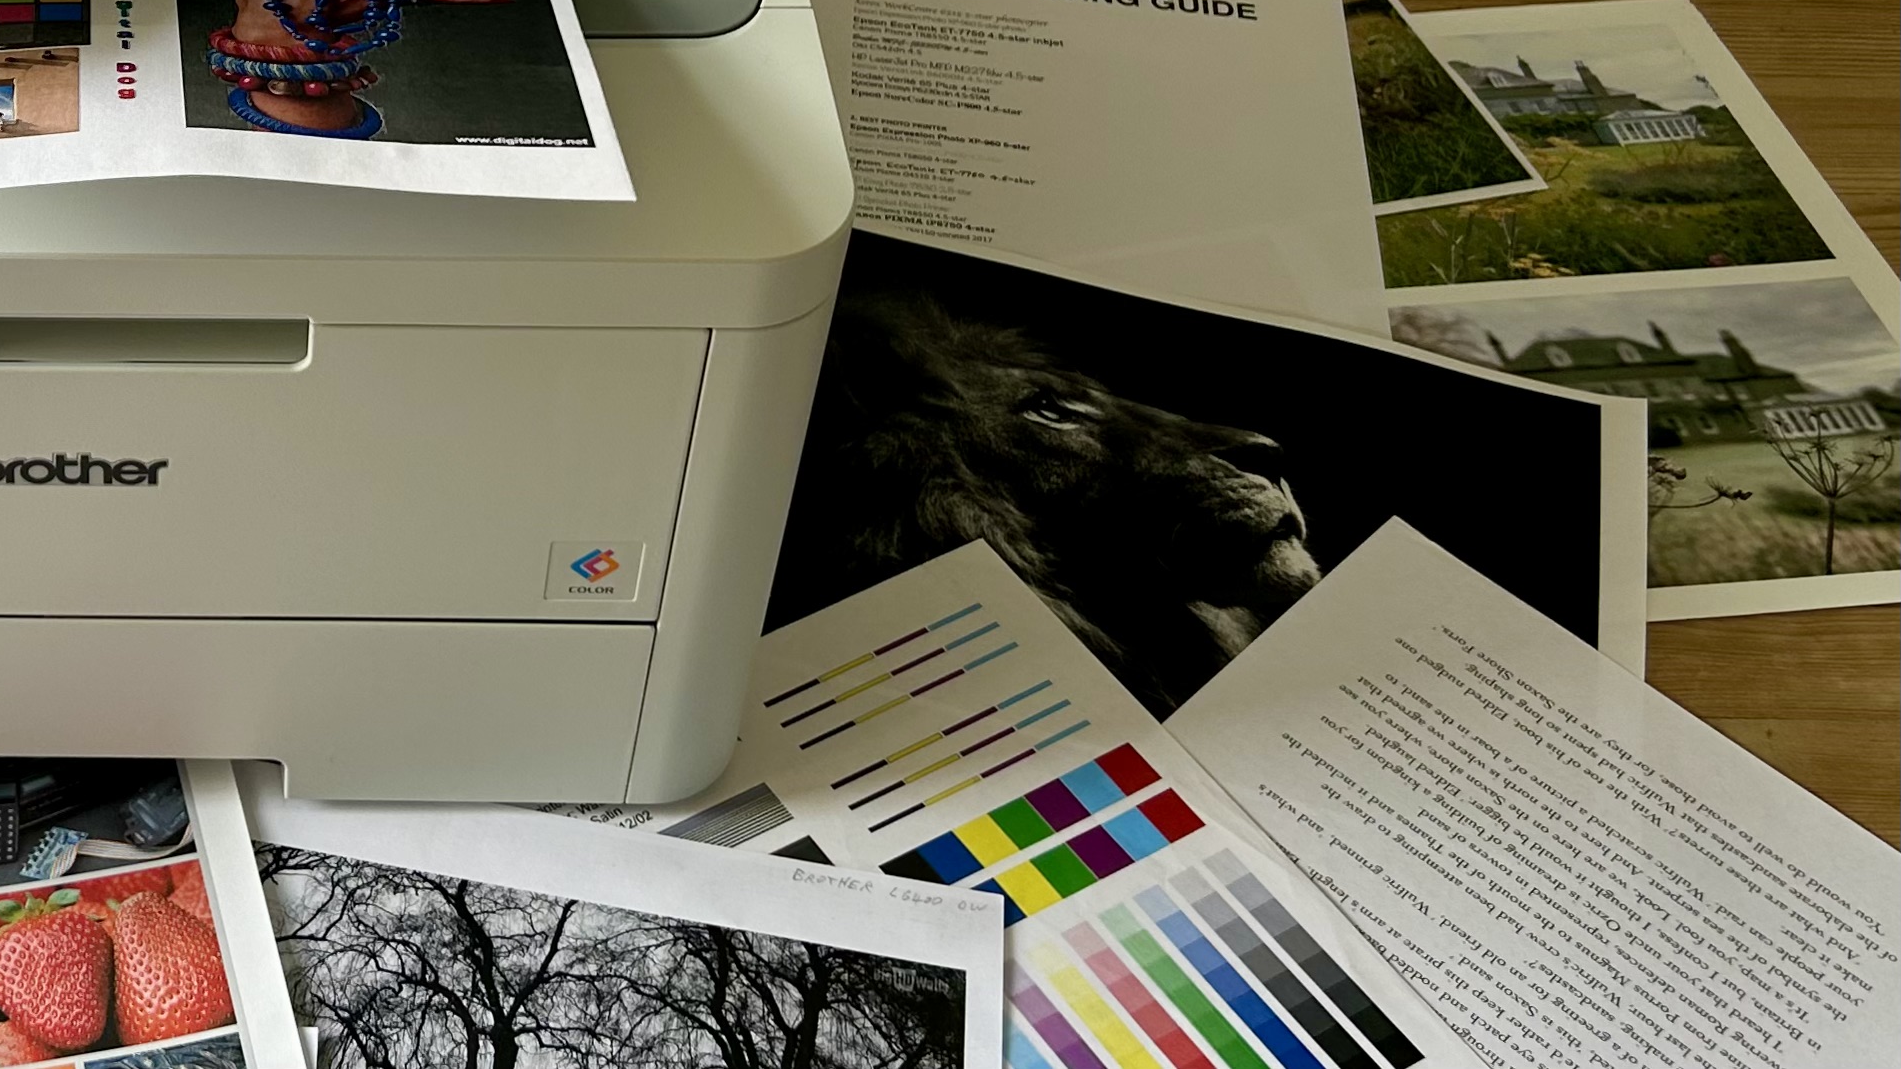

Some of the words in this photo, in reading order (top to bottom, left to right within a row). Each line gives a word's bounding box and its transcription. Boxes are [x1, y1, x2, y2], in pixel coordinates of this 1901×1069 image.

[852, 16, 886, 26] Epson
[889, 20, 937, 32] EcoTank
[1032, 37, 1063, 48] inkjet
[116, 63, 137, 99] Dog
[851, 71, 883, 80] Kodak
[851, 88, 881, 99] Epson
[849, 123, 879, 133] Epson
[882, 127, 935, 140] Expression
[937, 133, 965, 143] Photo
[880, 118, 909, 127] PHOTO
[912, 122, 947, 131] PRINTER
[455, 136, 588, 146] www.digitaldog.net
[568, 586, 614, 594] COLOR
[1394, 637, 1417, 654] one
[1415, 653, 1465, 688] nudged
[1476, 651, 1514, 680] Shore
[1384, 673, 1398, 685] to
[1462, 687, 1509, 721] Eldred
[1516, 678, 1555, 710] Saxon
[1433, 708, 1454, 725] the
[1514, 698, 1544, 724] long
[1557, 707, 1578, 724] the
[1456, 723, 1470, 738] in
[1545, 721, 1562, 733] so
[1579, 722, 1602, 739] are
[1469, 735, 1501, 760] boar
[1545, 742, 1566, 760] his
[1562, 731, 1598, 758] spent
[1602, 739, 1632, 760] they
[1503, 755, 1512, 768] a
[1507, 763, 1528, 775] of
[1561, 757, 1581, 768] of
[1596, 757, 1626, 779] had
[1632, 761, 1655, 776] for
[1582, 767, 1604, 784] toe
[1529, 774, 1579, 808] picture
[1605, 783, 1628, 800] the
[1626, 775, 1675, 815] Wulfric
[1578, 806, 1588, 815] a
[1630, 799, 1661, 828] With
[1695, 803, 1737, 830] avoid
[1678, 811, 1708, 833] that
[1586, 814, 1654, 860] scratched
[1738, 830, 1753, 843] to
[1710, 832, 1787, 887] sandcastles
[1752, 841, 1783, 865] well
[793, 868, 873, 893] BROTHER
[1653, 859, 1704, 902] Wulfric
[1725, 866, 1762, 893] these
[1786, 863, 1806, 878] do
[1763, 892, 1788, 910] are
[1804, 877, 1851, 910] would
[1787, 886, 1853, 933] elaborate
[1787, 909, 1824, 938] what
[1748, 926, 1773, 947] can
[1855, 932, 1879, 951] the
[1775, 946, 1826, 982] people
[1817, 953, 1831, 967] it
[1876, 950, 1898, 962] of
[1832, 962, 1873, 992] make
[1823, 982, 1865, 1007] your
